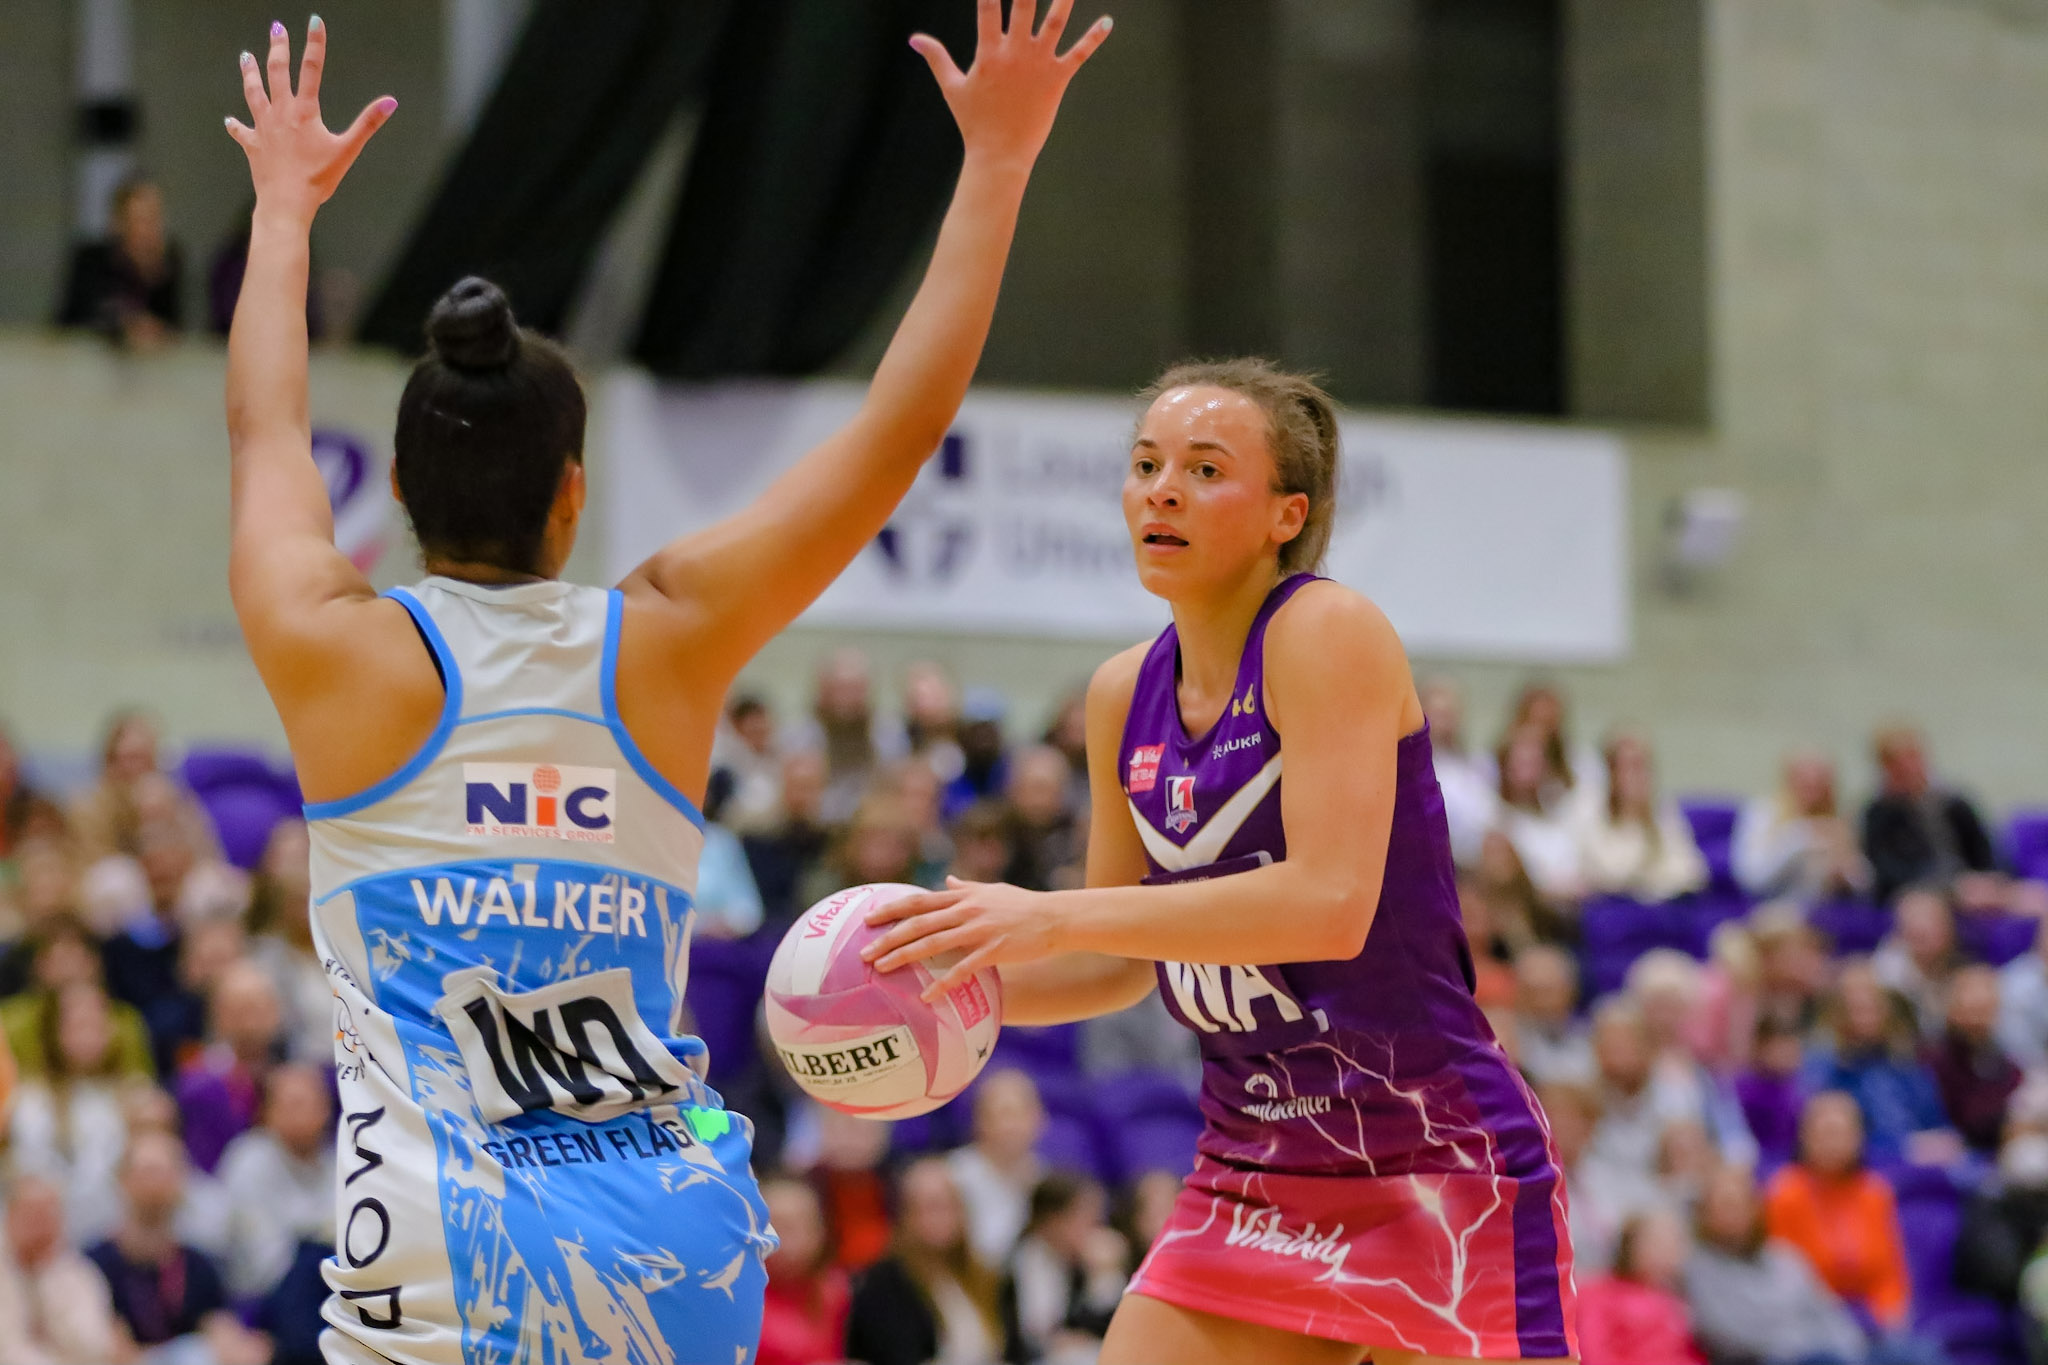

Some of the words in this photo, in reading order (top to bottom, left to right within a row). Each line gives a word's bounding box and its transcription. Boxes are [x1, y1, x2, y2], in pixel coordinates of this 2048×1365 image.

[466, 826, 485, 836] FM
[492, 826, 562, 839] SERVICES
[566, 830, 614, 843] GROUP
[410, 877, 648, 938] WALKER
[1165, 961, 1303, 1033] WA
[482, 1127, 608, 1169] GREEN
[606, 1119, 696, 1160] FLAG
[1225, 1203, 1351, 1282] Vitality
